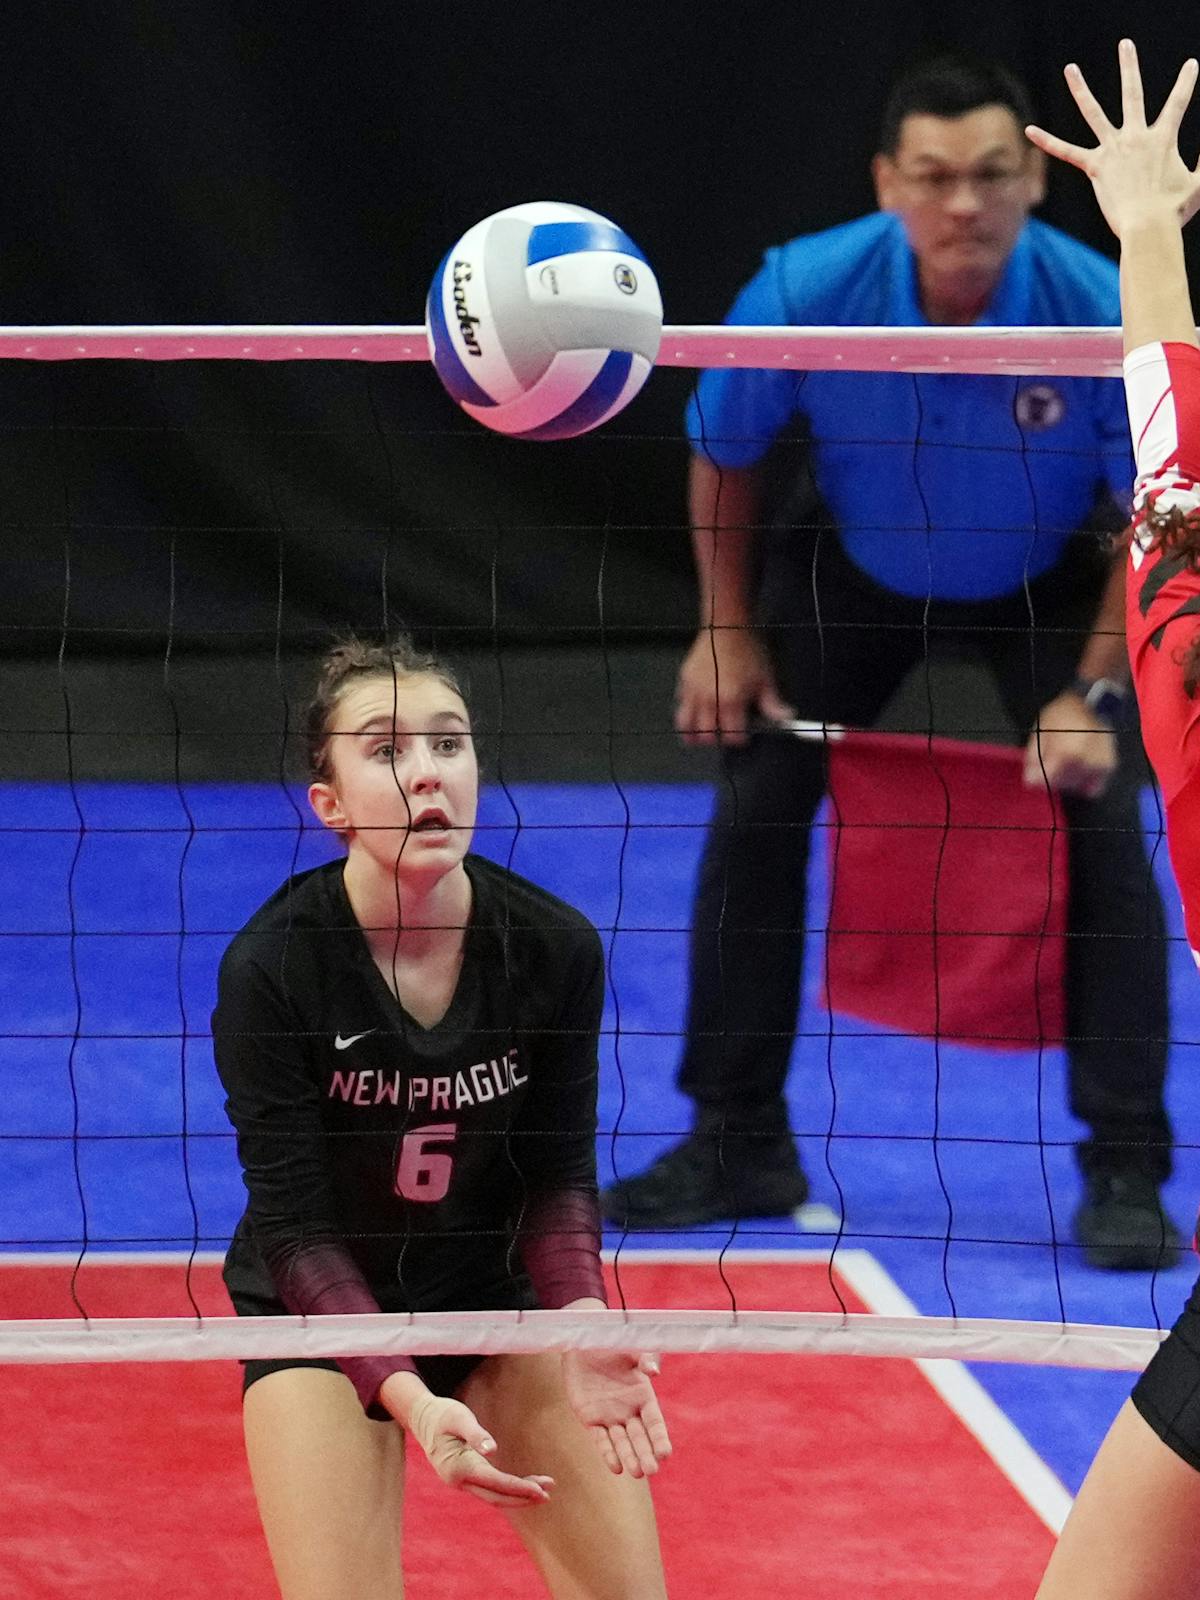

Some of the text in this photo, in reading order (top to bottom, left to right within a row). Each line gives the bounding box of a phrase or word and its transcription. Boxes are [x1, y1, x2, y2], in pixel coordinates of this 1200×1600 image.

[329, 1048, 528, 1112] NEW PRAGUE
[395, 1123, 457, 1203] 6
